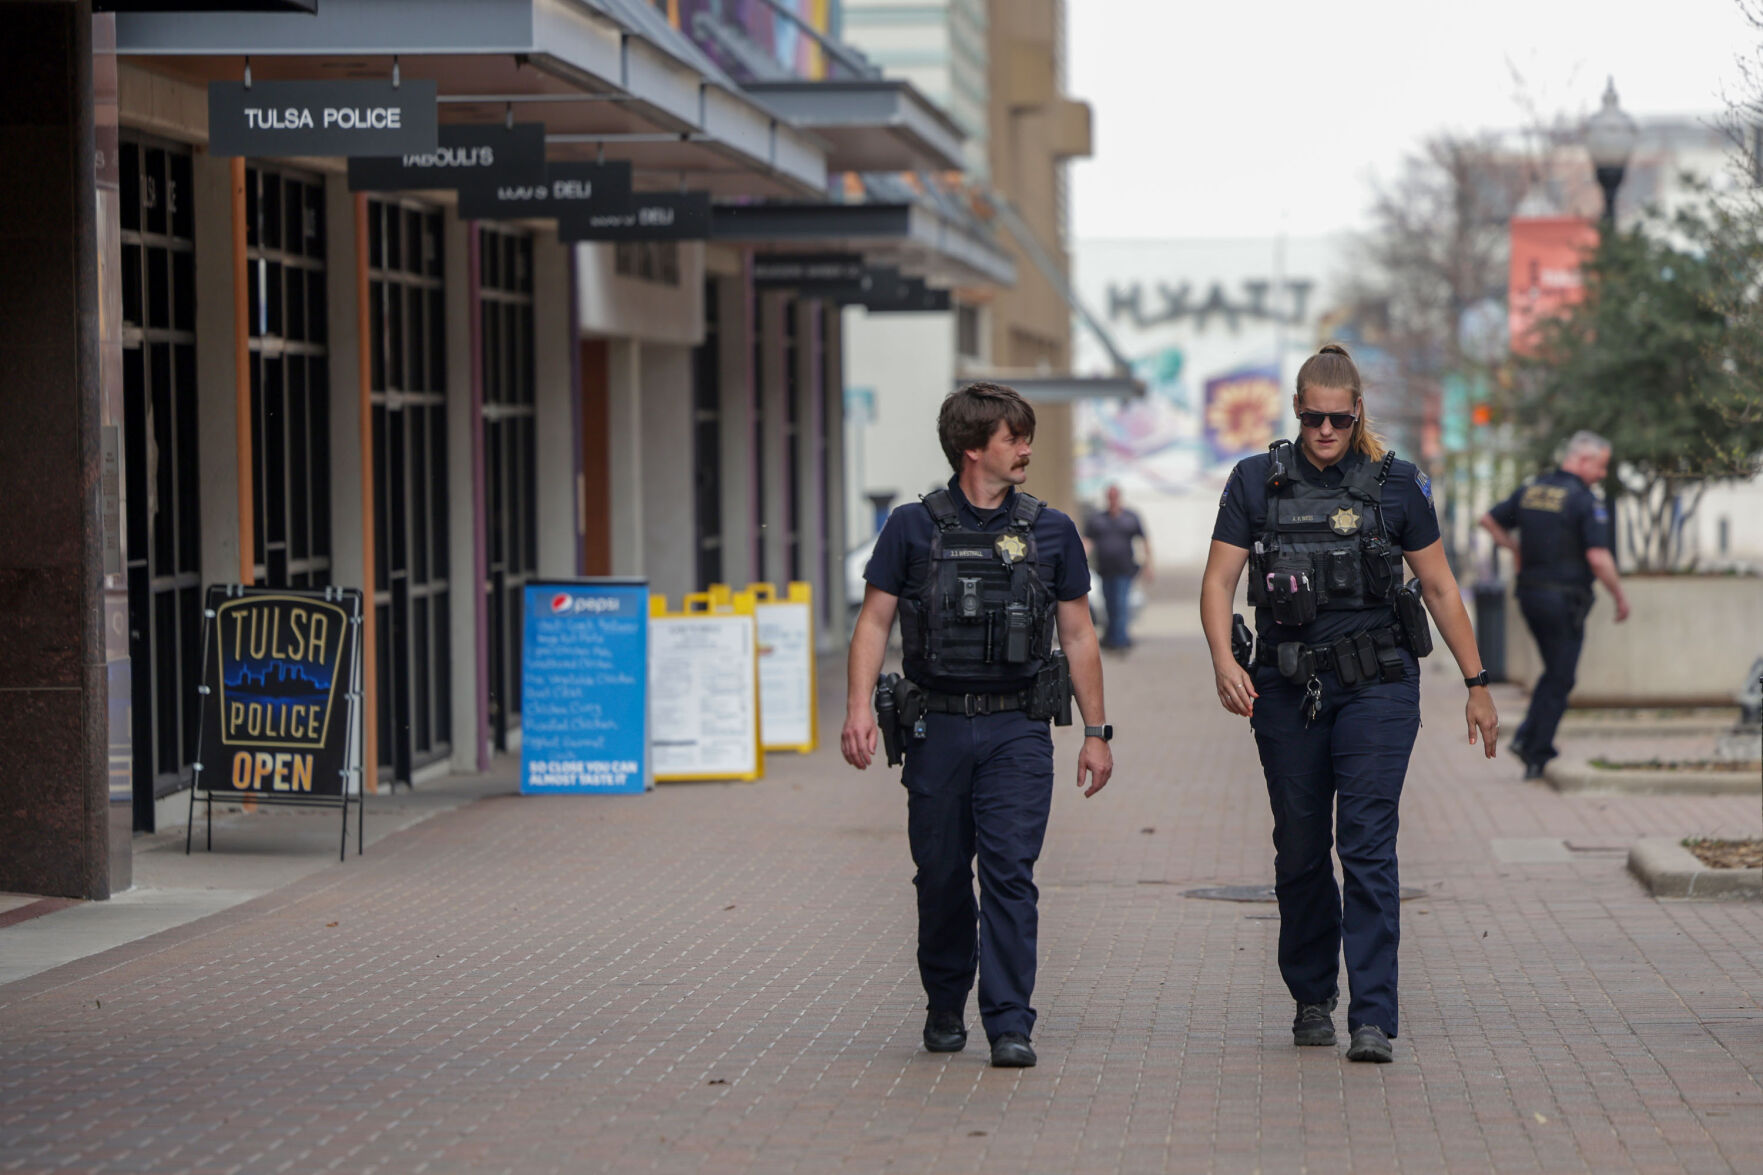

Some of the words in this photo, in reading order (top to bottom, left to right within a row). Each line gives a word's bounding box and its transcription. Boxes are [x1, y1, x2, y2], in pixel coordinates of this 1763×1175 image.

[244, 107, 314, 130] TULSA
[323, 107, 402, 130] POLICE
[552, 179, 593, 201] DELI
[638, 206, 676, 227] DELI
[1105, 279, 1317, 335] HYATT
[574, 597, 621, 614] pepsi
[231, 605, 329, 665] TULSA
[229, 700, 322, 741] POLICE
[231, 750, 314, 793] OPEN
[528, 759, 547, 774] SO
[547, 759, 584, 774] CLOSE
[584, 759, 611, 774] YOU
[611, 759, 639, 775] CAN
[528, 773, 577, 787] ALMOST
[578, 773, 615, 787] TASTE
